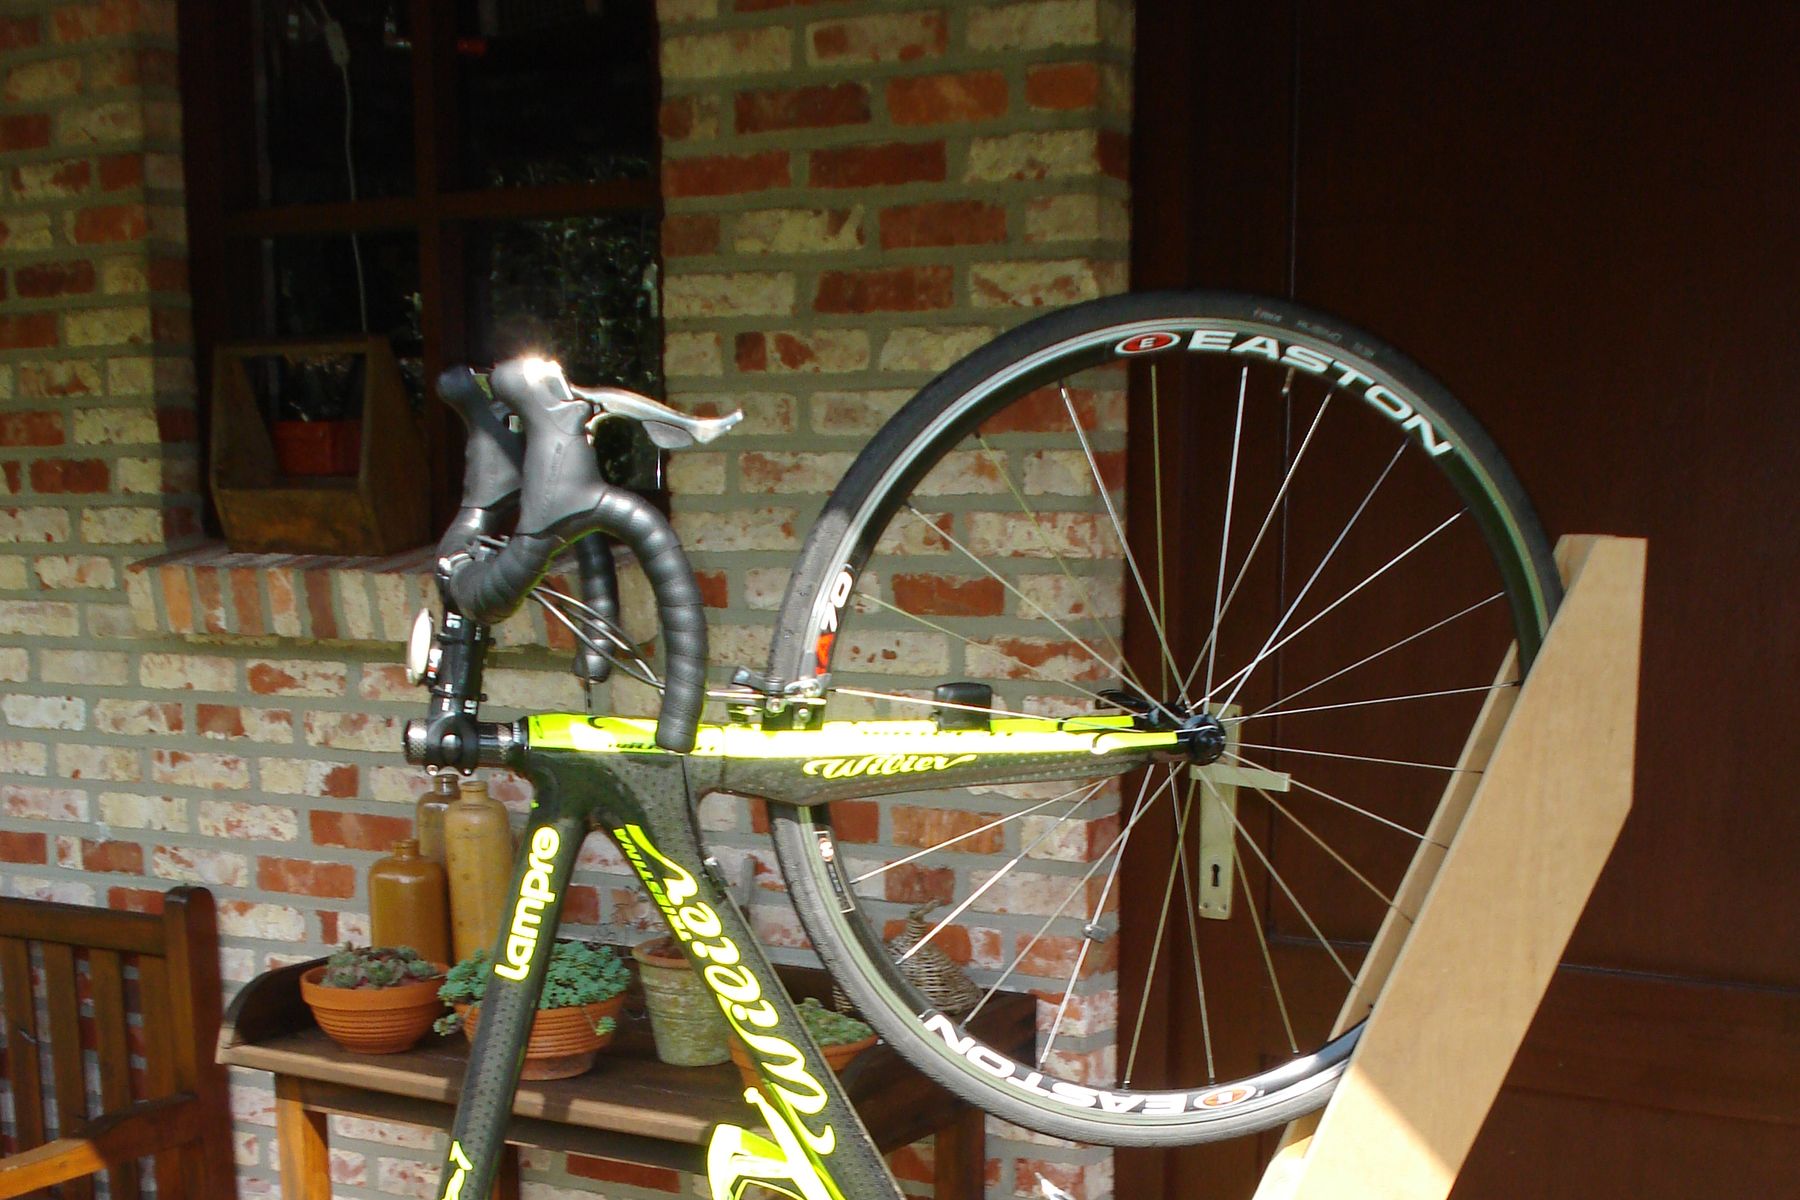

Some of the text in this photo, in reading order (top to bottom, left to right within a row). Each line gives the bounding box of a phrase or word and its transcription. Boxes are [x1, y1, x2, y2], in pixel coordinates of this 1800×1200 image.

[1187, 329, 1453, 457] EASTON
[802, 753, 977, 780] Wilier
[624, 823, 837, 1156] Wilier
[923, 1014, 1188, 1115] EASTON
